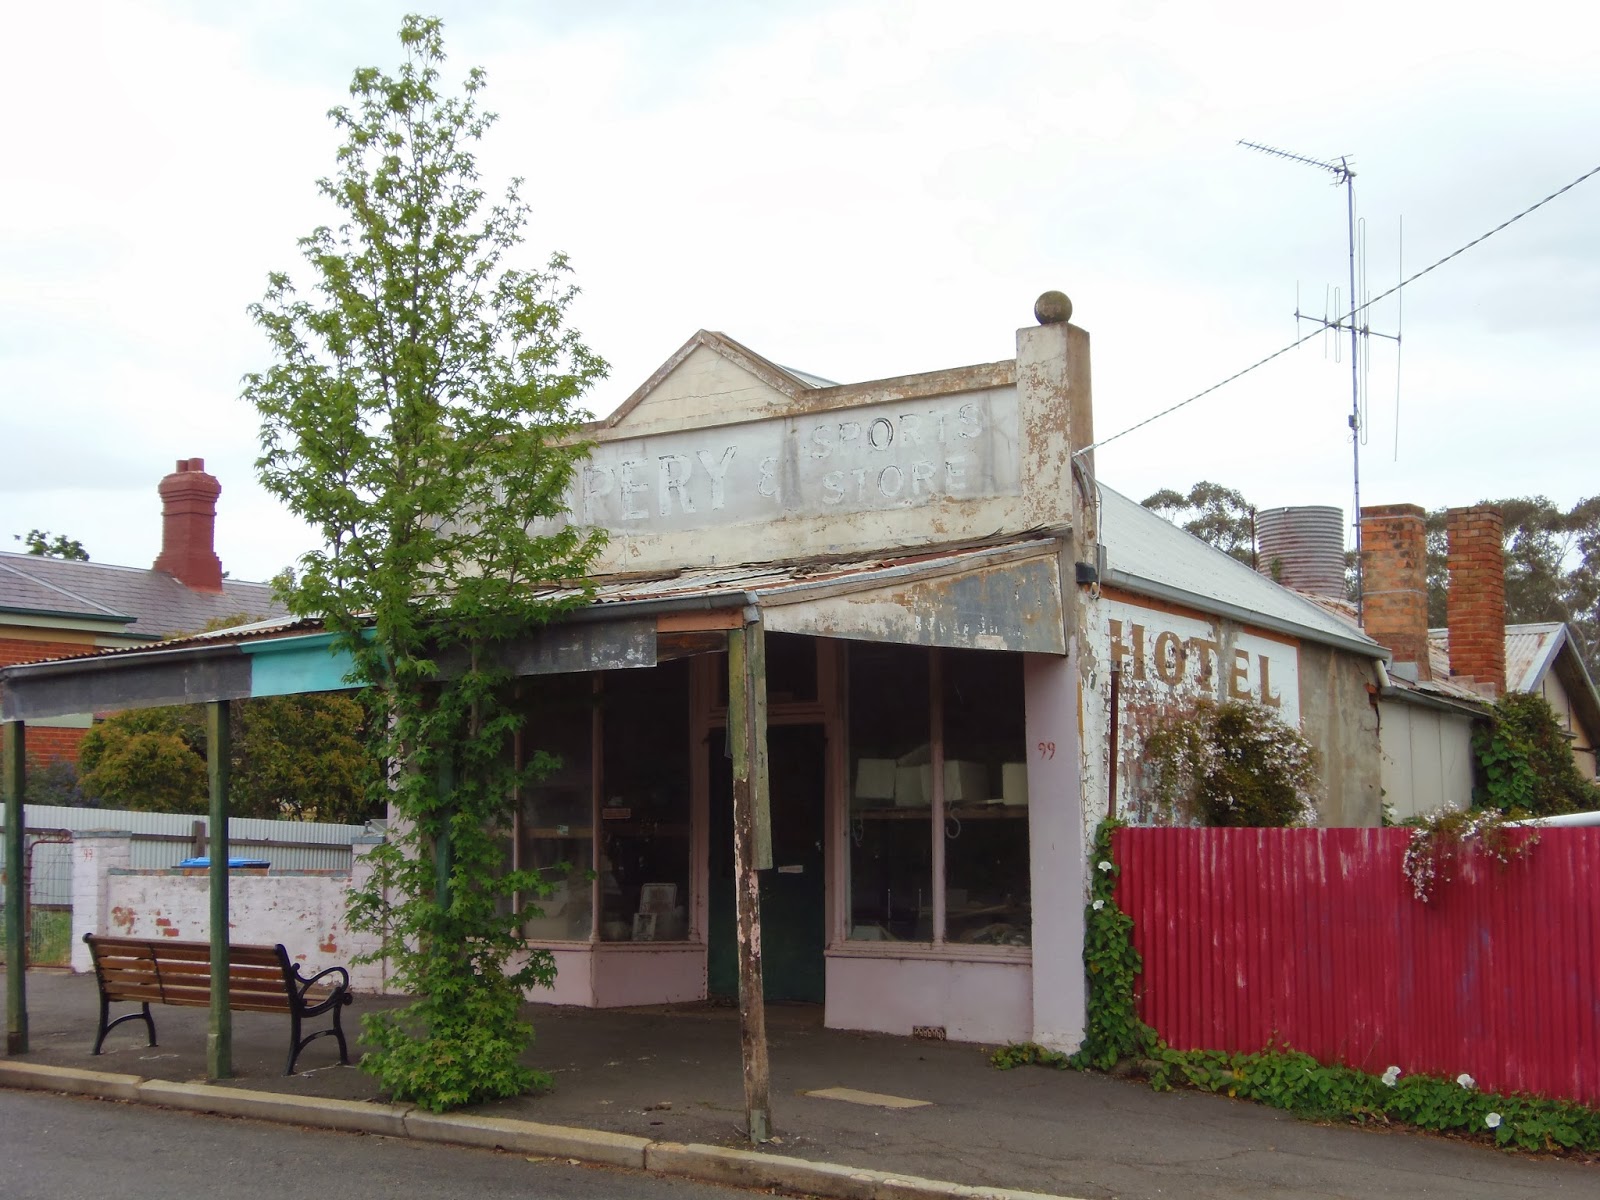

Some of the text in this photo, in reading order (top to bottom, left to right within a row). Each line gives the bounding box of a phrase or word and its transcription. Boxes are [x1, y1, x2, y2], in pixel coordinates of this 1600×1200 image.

[811, 403, 982, 459] SPORTS
[822, 456, 967, 504] STORE
[1108, 619, 1281, 708] HOTEL
[1038, 742, 1056, 760] 99
